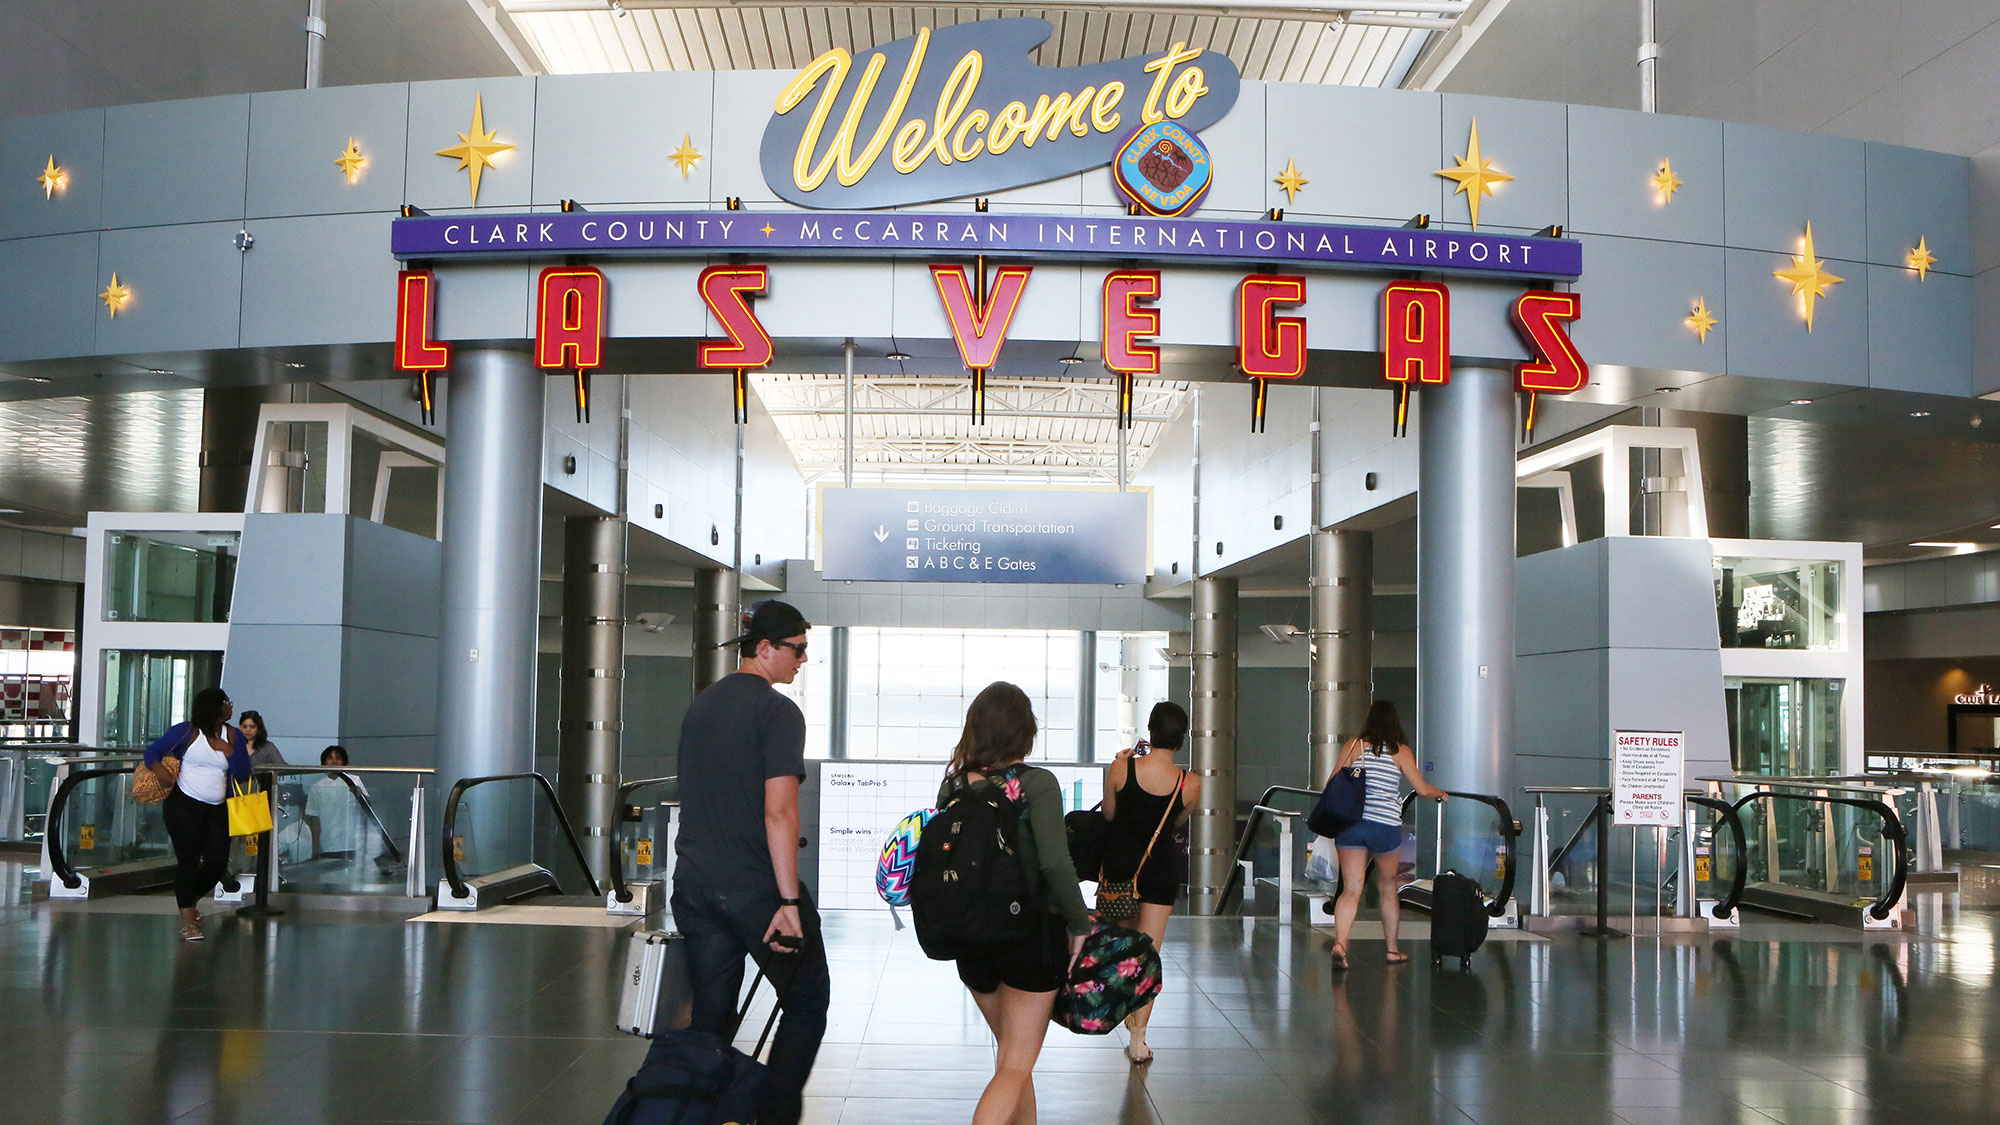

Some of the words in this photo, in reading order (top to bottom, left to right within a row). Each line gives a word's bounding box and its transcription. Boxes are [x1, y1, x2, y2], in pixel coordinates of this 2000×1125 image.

[775, 27, 1124, 191] Welcome
[1142, 41, 1209, 124] to
[1127, 128, 1160, 164] CLARK
[1162, 126, 1206, 165] COUNTY
[1140, 184, 1193, 206] NEVADA
[445, 224, 553, 245] CLARK
[583, 221, 733, 242] COUNTY
[801, 219, 1007, 242] McCARRAN
[1039, 223, 1354, 254] INTERNATIONAL
[1382, 237, 1532, 264] AIRPORT
[394, 264, 774, 371] LAS
[928, 264, 1589, 395] VEGAS
[924, 501, 984, 517] Baggage
[988, 501, 1028, 515] Claim
[924, 519, 976, 533] Ground
[981, 520, 1074, 536] Transportation
[925, 537, 981, 554] Ticketing
[924, 556, 935, 569] A
[940, 556, 948, 569] B
[953, 556, 965, 569] C
[969, 557, 980, 570] &
[985, 557, 993, 570] E
[998, 557, 1036, 571] Gates
[1955, 694, 1984, 705] CLUB
[1618, 736, 1650, 746] SAFETY
[1652, 737, 1679, 747] RULES
[830, 779, 855, 787] Galaxy
[830, 827, 854, 835] Simple
[855, 827, 872, 835] wins
